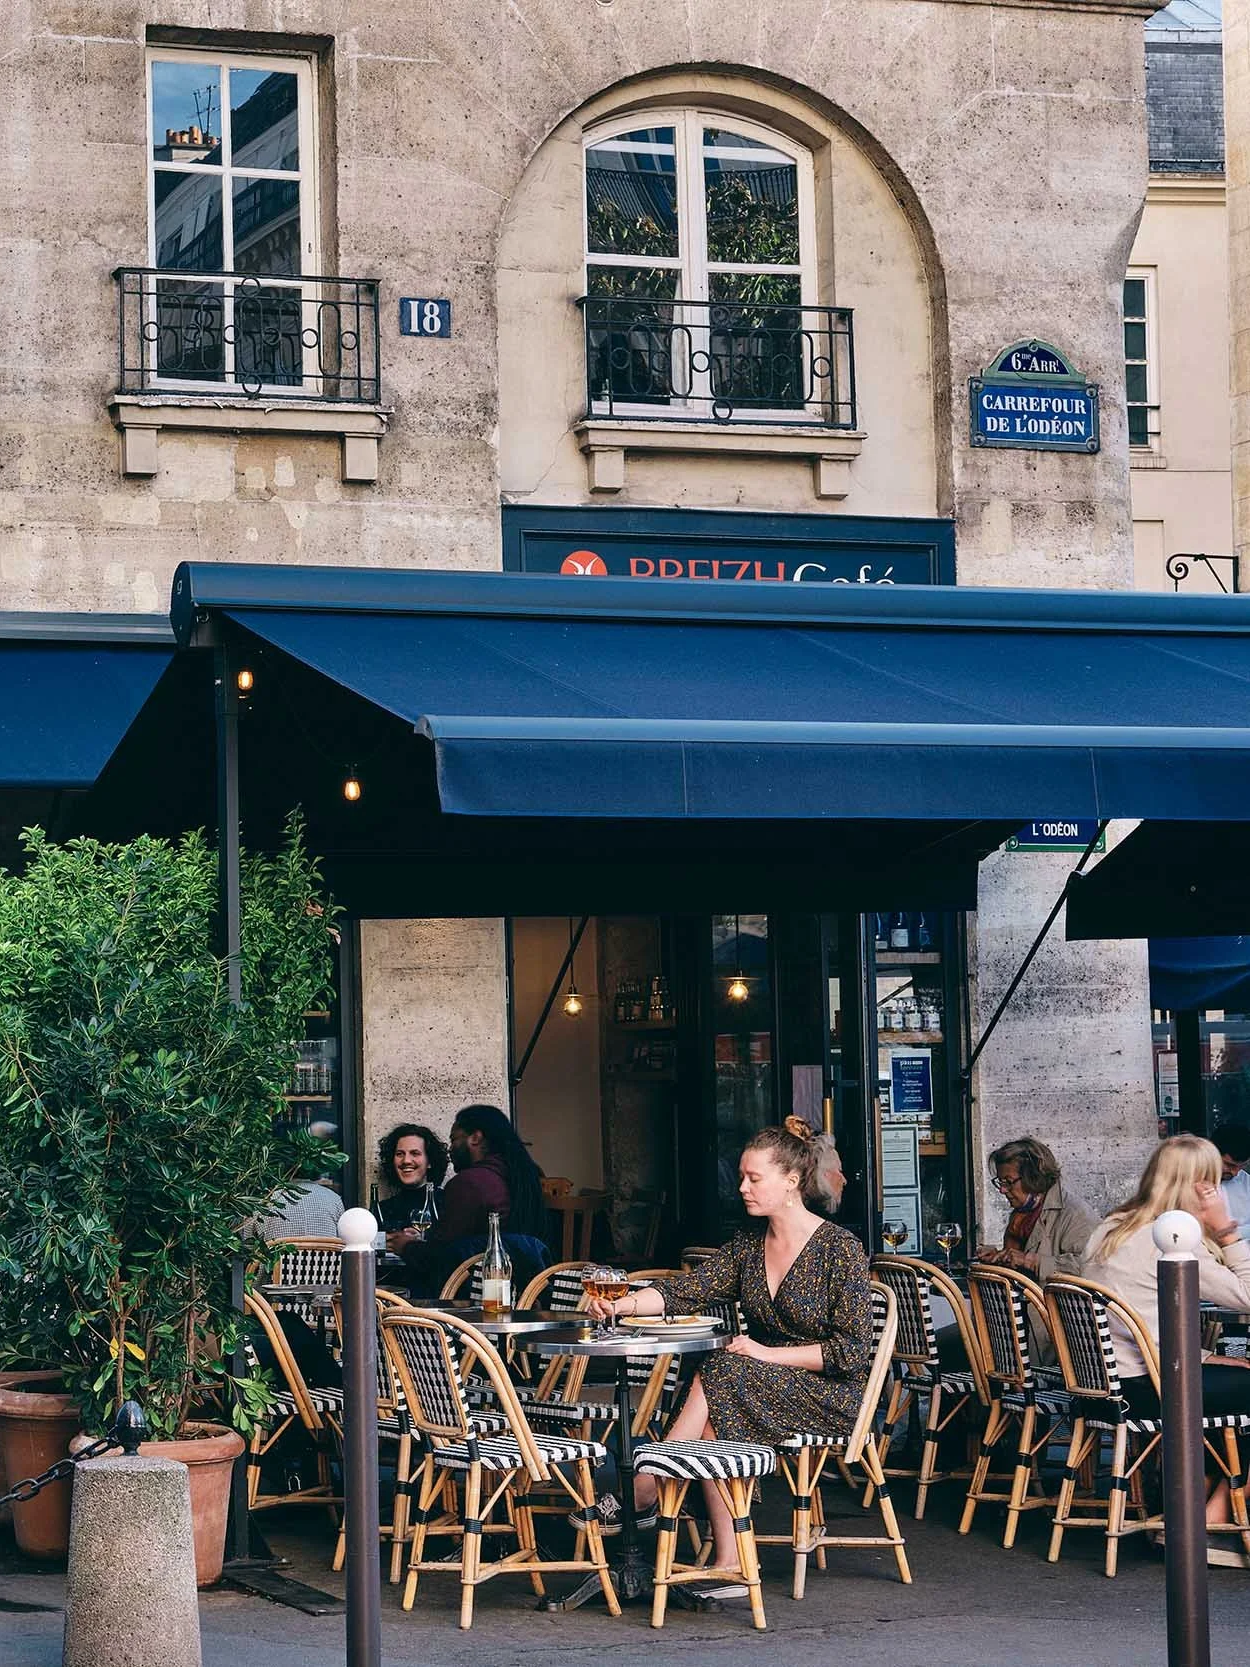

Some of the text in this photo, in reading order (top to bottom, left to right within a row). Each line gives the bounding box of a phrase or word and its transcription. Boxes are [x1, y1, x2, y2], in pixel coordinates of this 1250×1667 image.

[408, 300, 442, 334] 18
[982, 394, 1087, 415] CARREFOUR
[985, 414, 1085, 436] DE L'ODÉON
[1032, 821, 1078, 837] L'ODÉON
